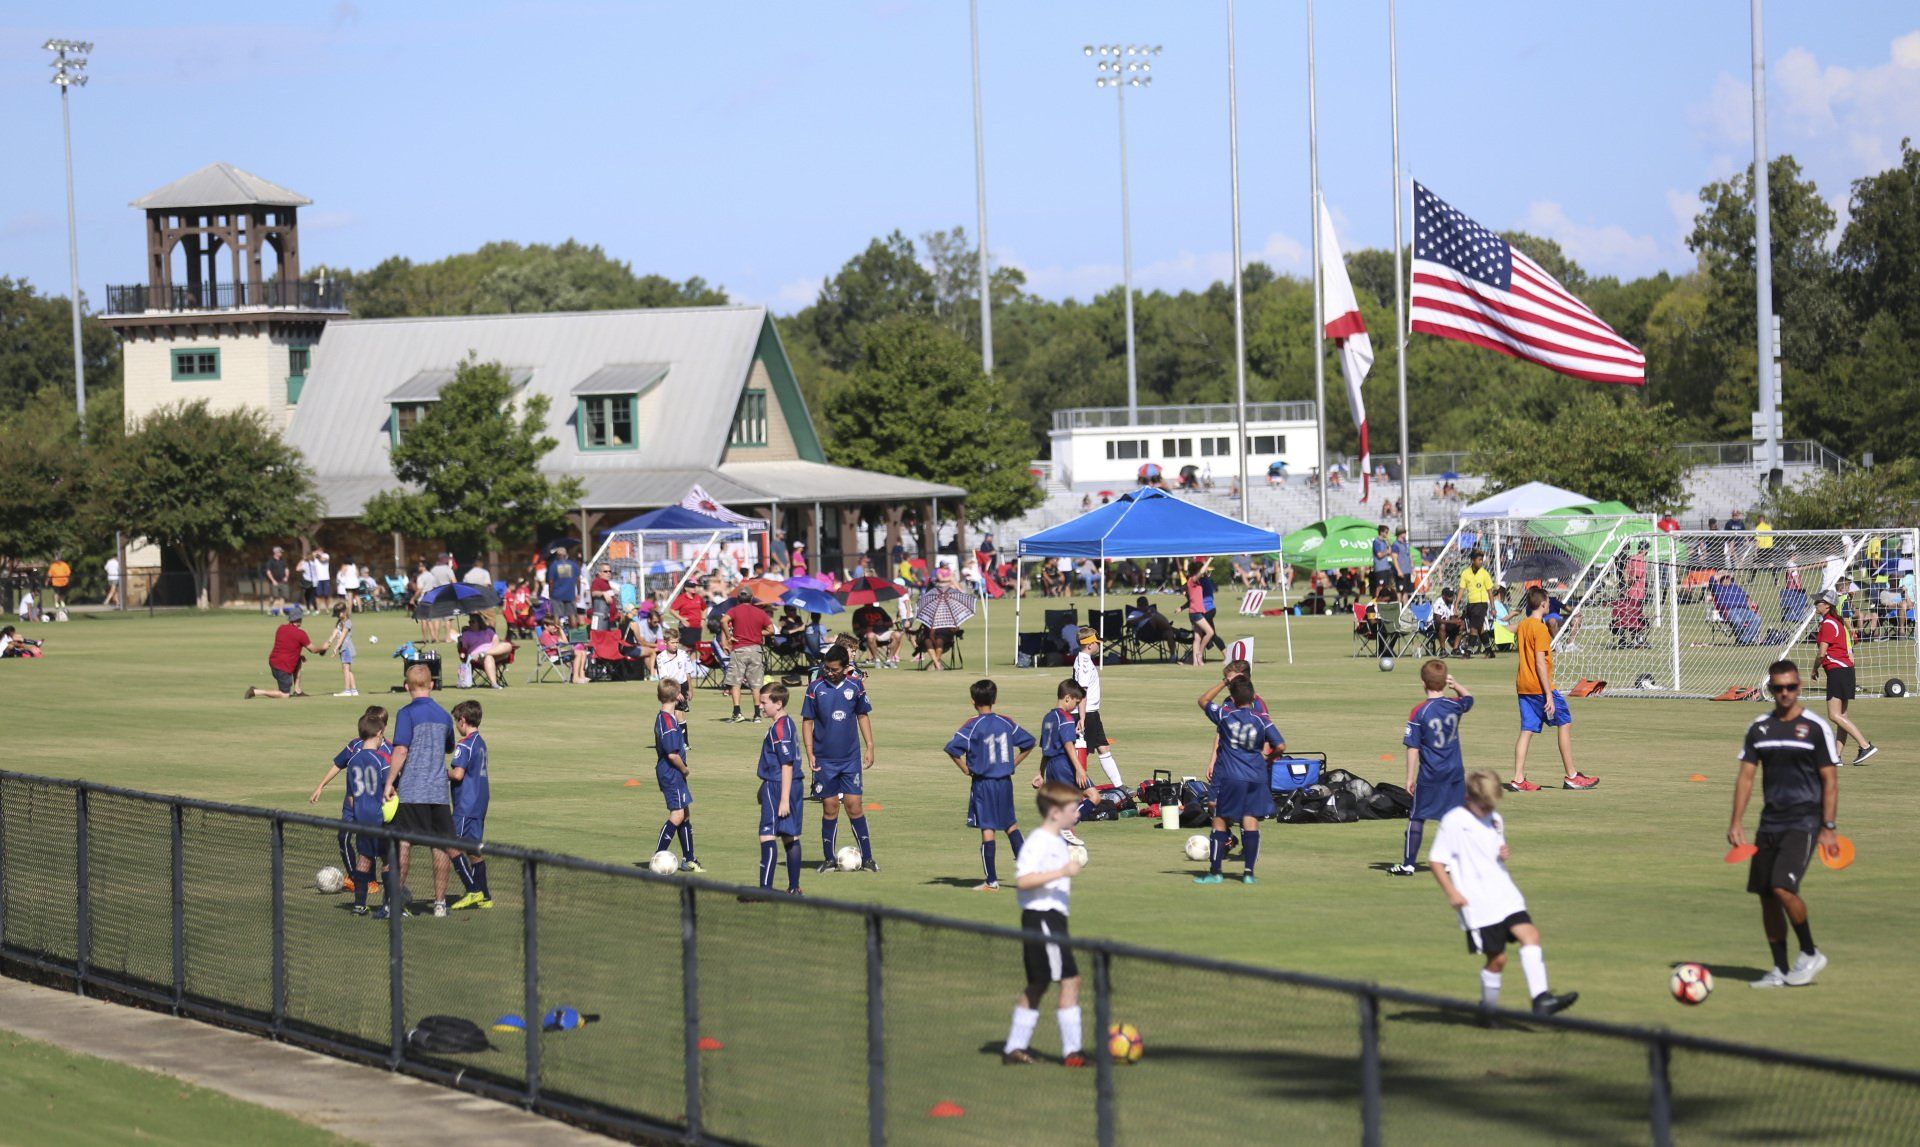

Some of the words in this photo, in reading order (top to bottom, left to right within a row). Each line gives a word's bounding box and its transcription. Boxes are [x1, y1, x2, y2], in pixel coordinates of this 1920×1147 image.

[1242, 592, 1263, 612] 10
[1228, 721, 1258, 751] 10
[1428, 713, 1459, 748] 32
[984, 732, 1010, 764] 11
[352, 766, 378, 797] 30
[853, 773, 860, 787] 4
